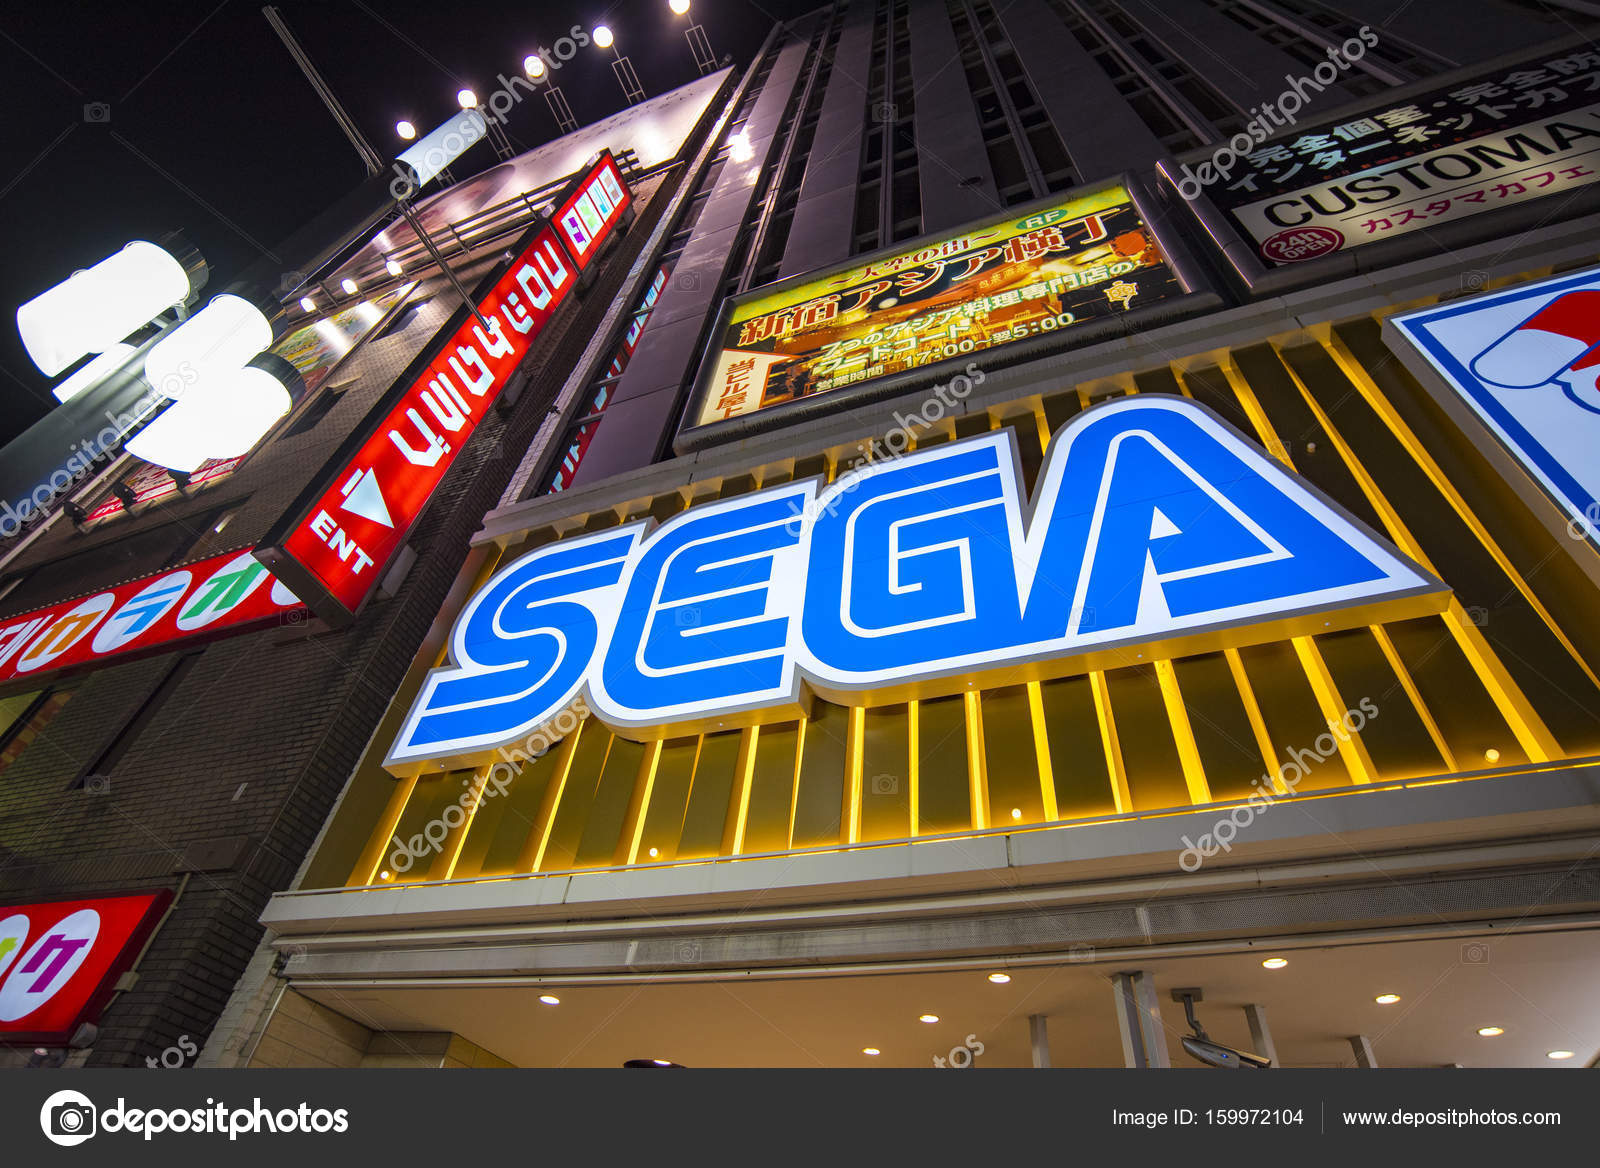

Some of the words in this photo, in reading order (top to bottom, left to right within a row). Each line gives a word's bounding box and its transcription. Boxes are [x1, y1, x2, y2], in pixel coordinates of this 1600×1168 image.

[1263, 122, 1600, 228] CUSTOMA
[1361, 164, 1595, 234] カスタマカフェ
[1025, 209, 1061, 229] RF
[1271, 229, 1321, 254] 24h
[1283, 237, 1333, 260] OPEN
[737, 207, 1121, 347] 新宿アジア横丁
[816, 364, 885, 393] 営業時間
[309, 509, 374, 575] ENT
[386, 396, 1445, 768] SEGA
